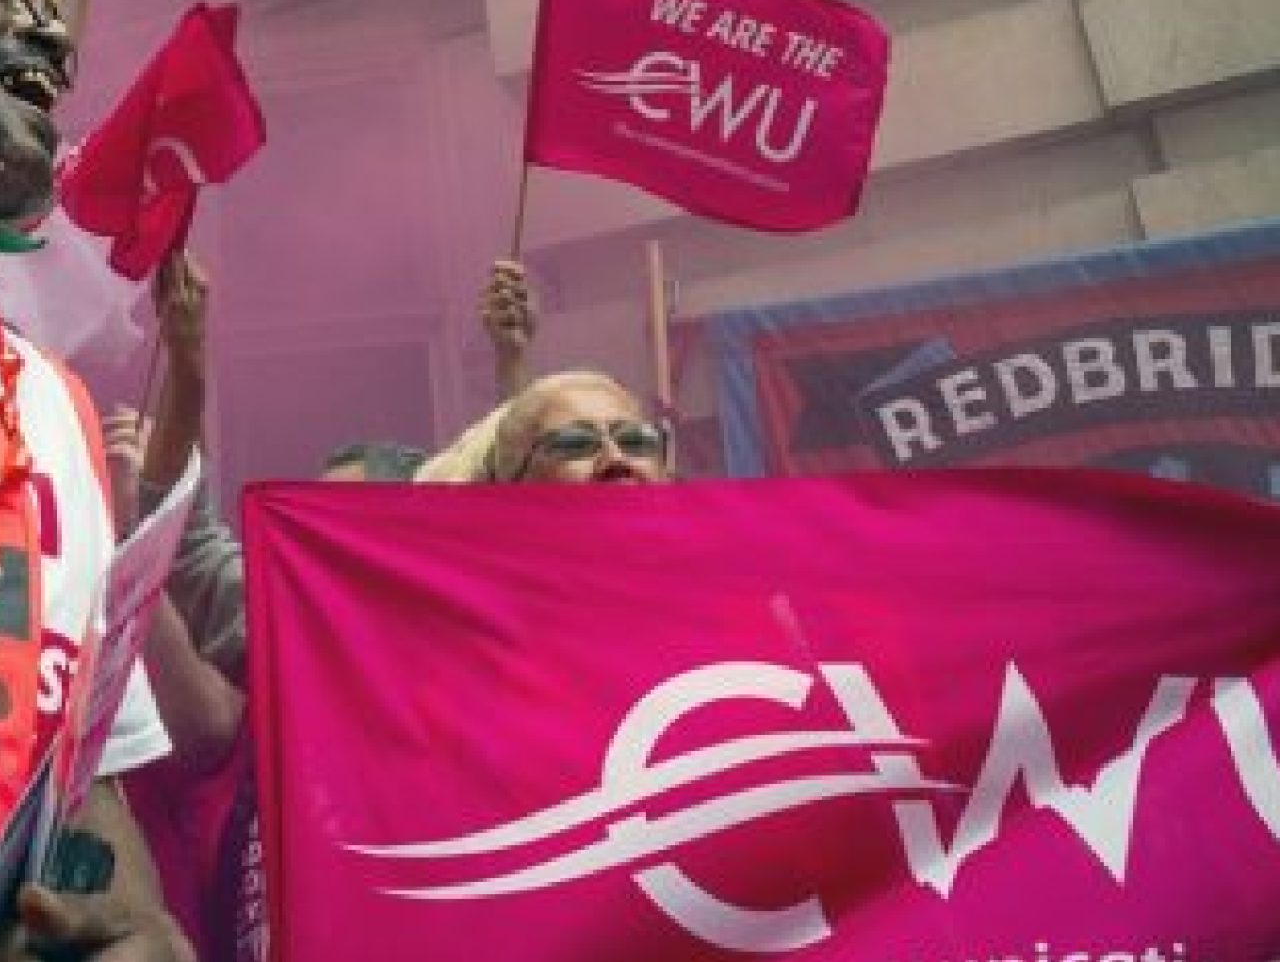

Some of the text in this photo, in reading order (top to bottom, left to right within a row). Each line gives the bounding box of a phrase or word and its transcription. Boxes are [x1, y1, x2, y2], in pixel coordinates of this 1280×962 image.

[706, 11, 777, 56] ARE
[781, 31, 844, 78] THE
[573, 51, 819, 163] CWU
